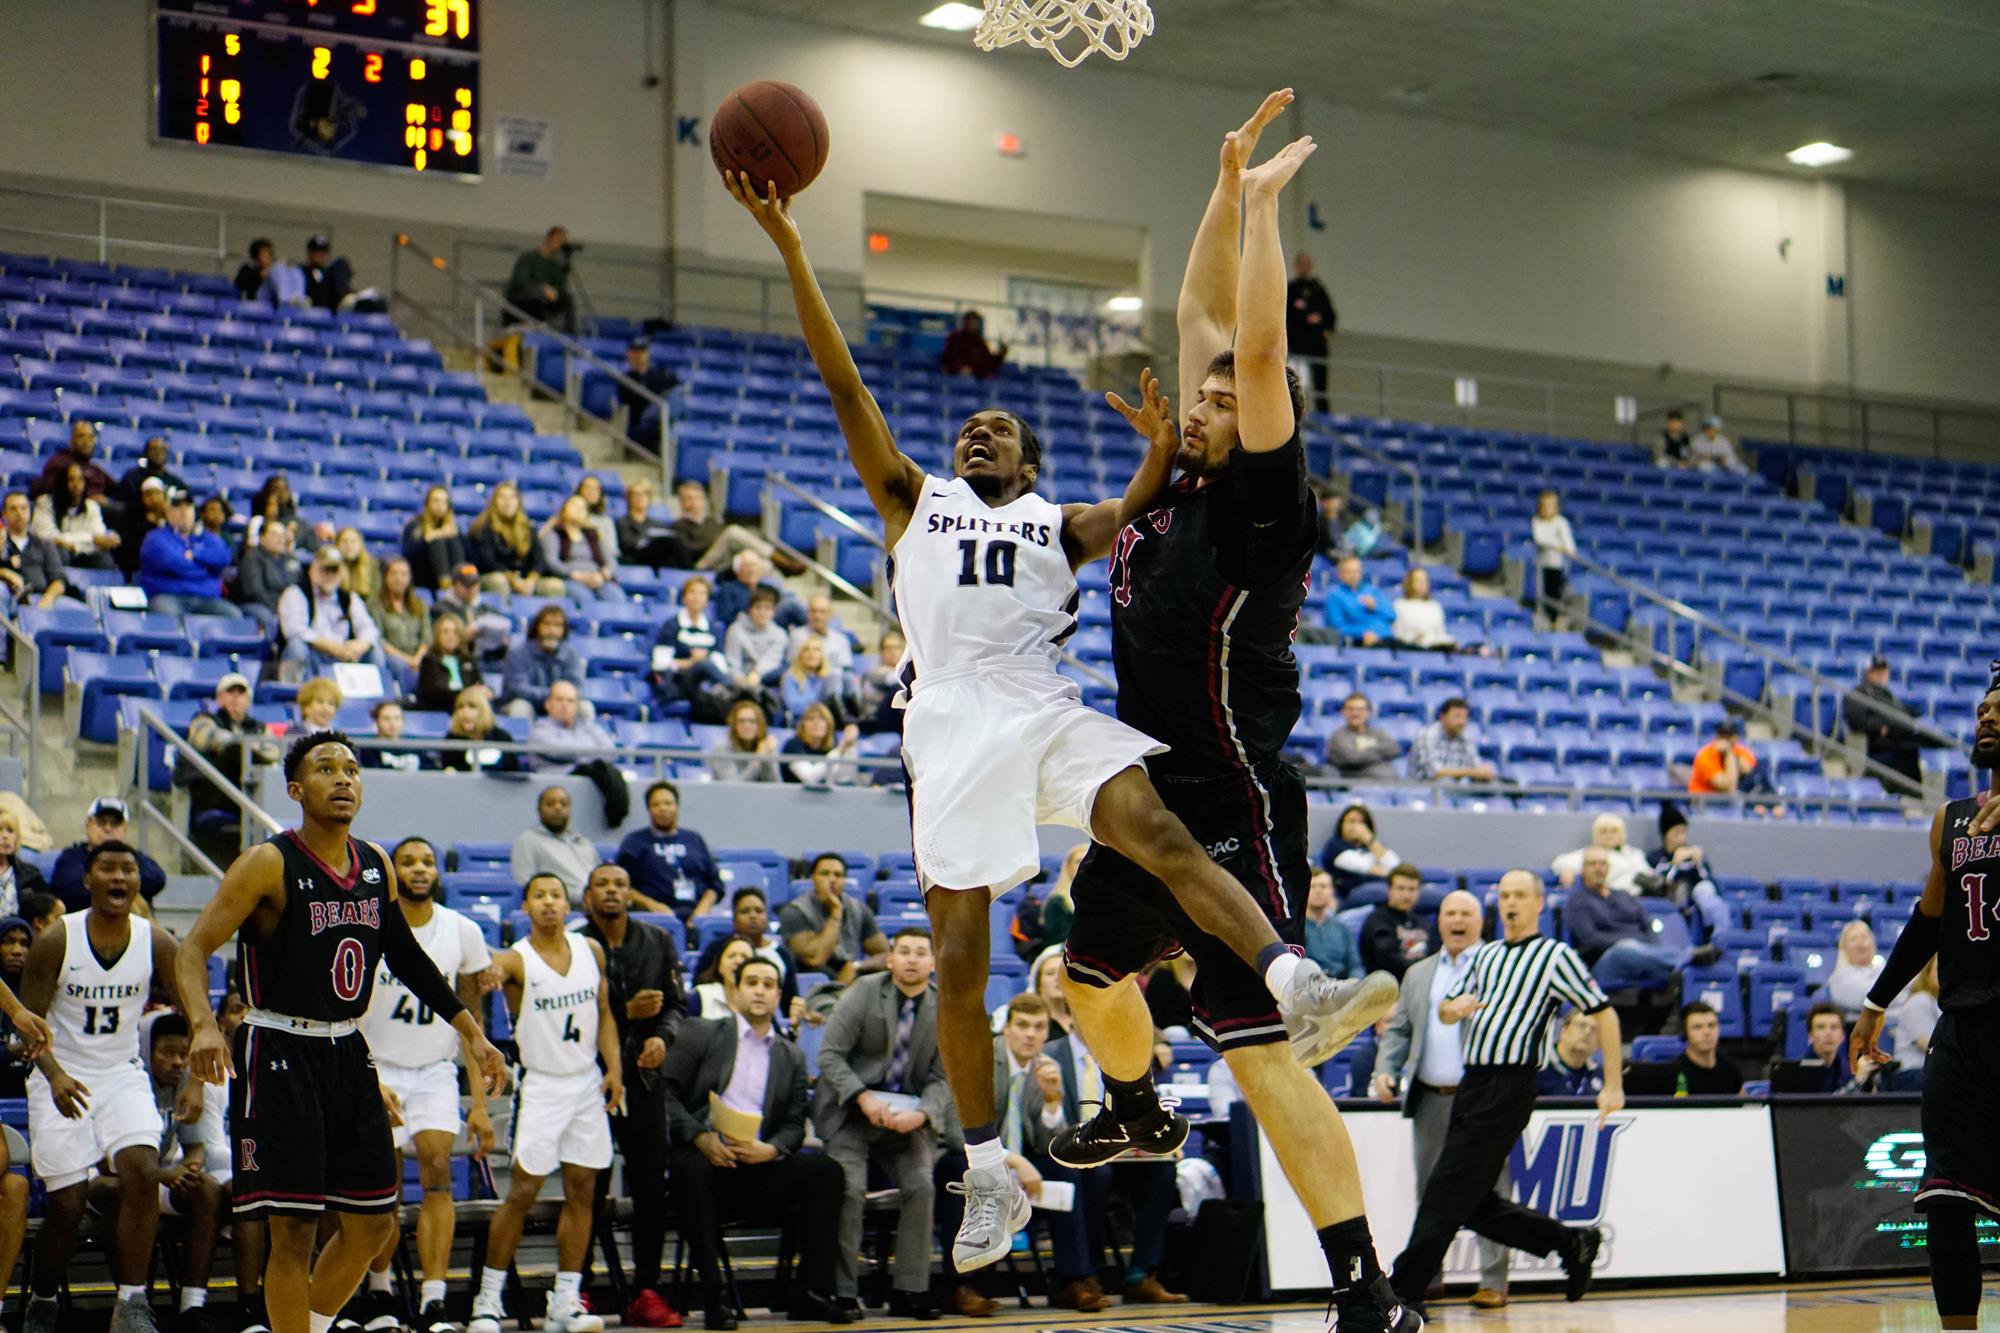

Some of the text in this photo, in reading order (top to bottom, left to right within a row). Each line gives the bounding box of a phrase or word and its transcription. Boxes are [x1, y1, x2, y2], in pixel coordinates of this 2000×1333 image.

[425, 0, 470, 39] 37
[364, 53, 383, 83] 2
[196, 99, 209, 116] 2
[677, 116, 701, 146] K
[1308, 204, 1326, 231] L
[1827, 273, 1844, 297] M
[928, 513, 1051, 547] SPLITTERS
[957, 539, 1017, 588] 10
[1109, 524, 1145, 607] 1
[309, 897, 380, 936] BEARS
[1961, 873, 2000, 941] 1
[330, 937, 367, 1001] 0
[66, 983, 140, 999] SPLITTERS
[534, 986, 595, 1011] SPLITTERS
[83, 1006, 119, 1035] 13
[391, 994, 435, 1026] 40
[562, 1013, 580, 1042] 4
